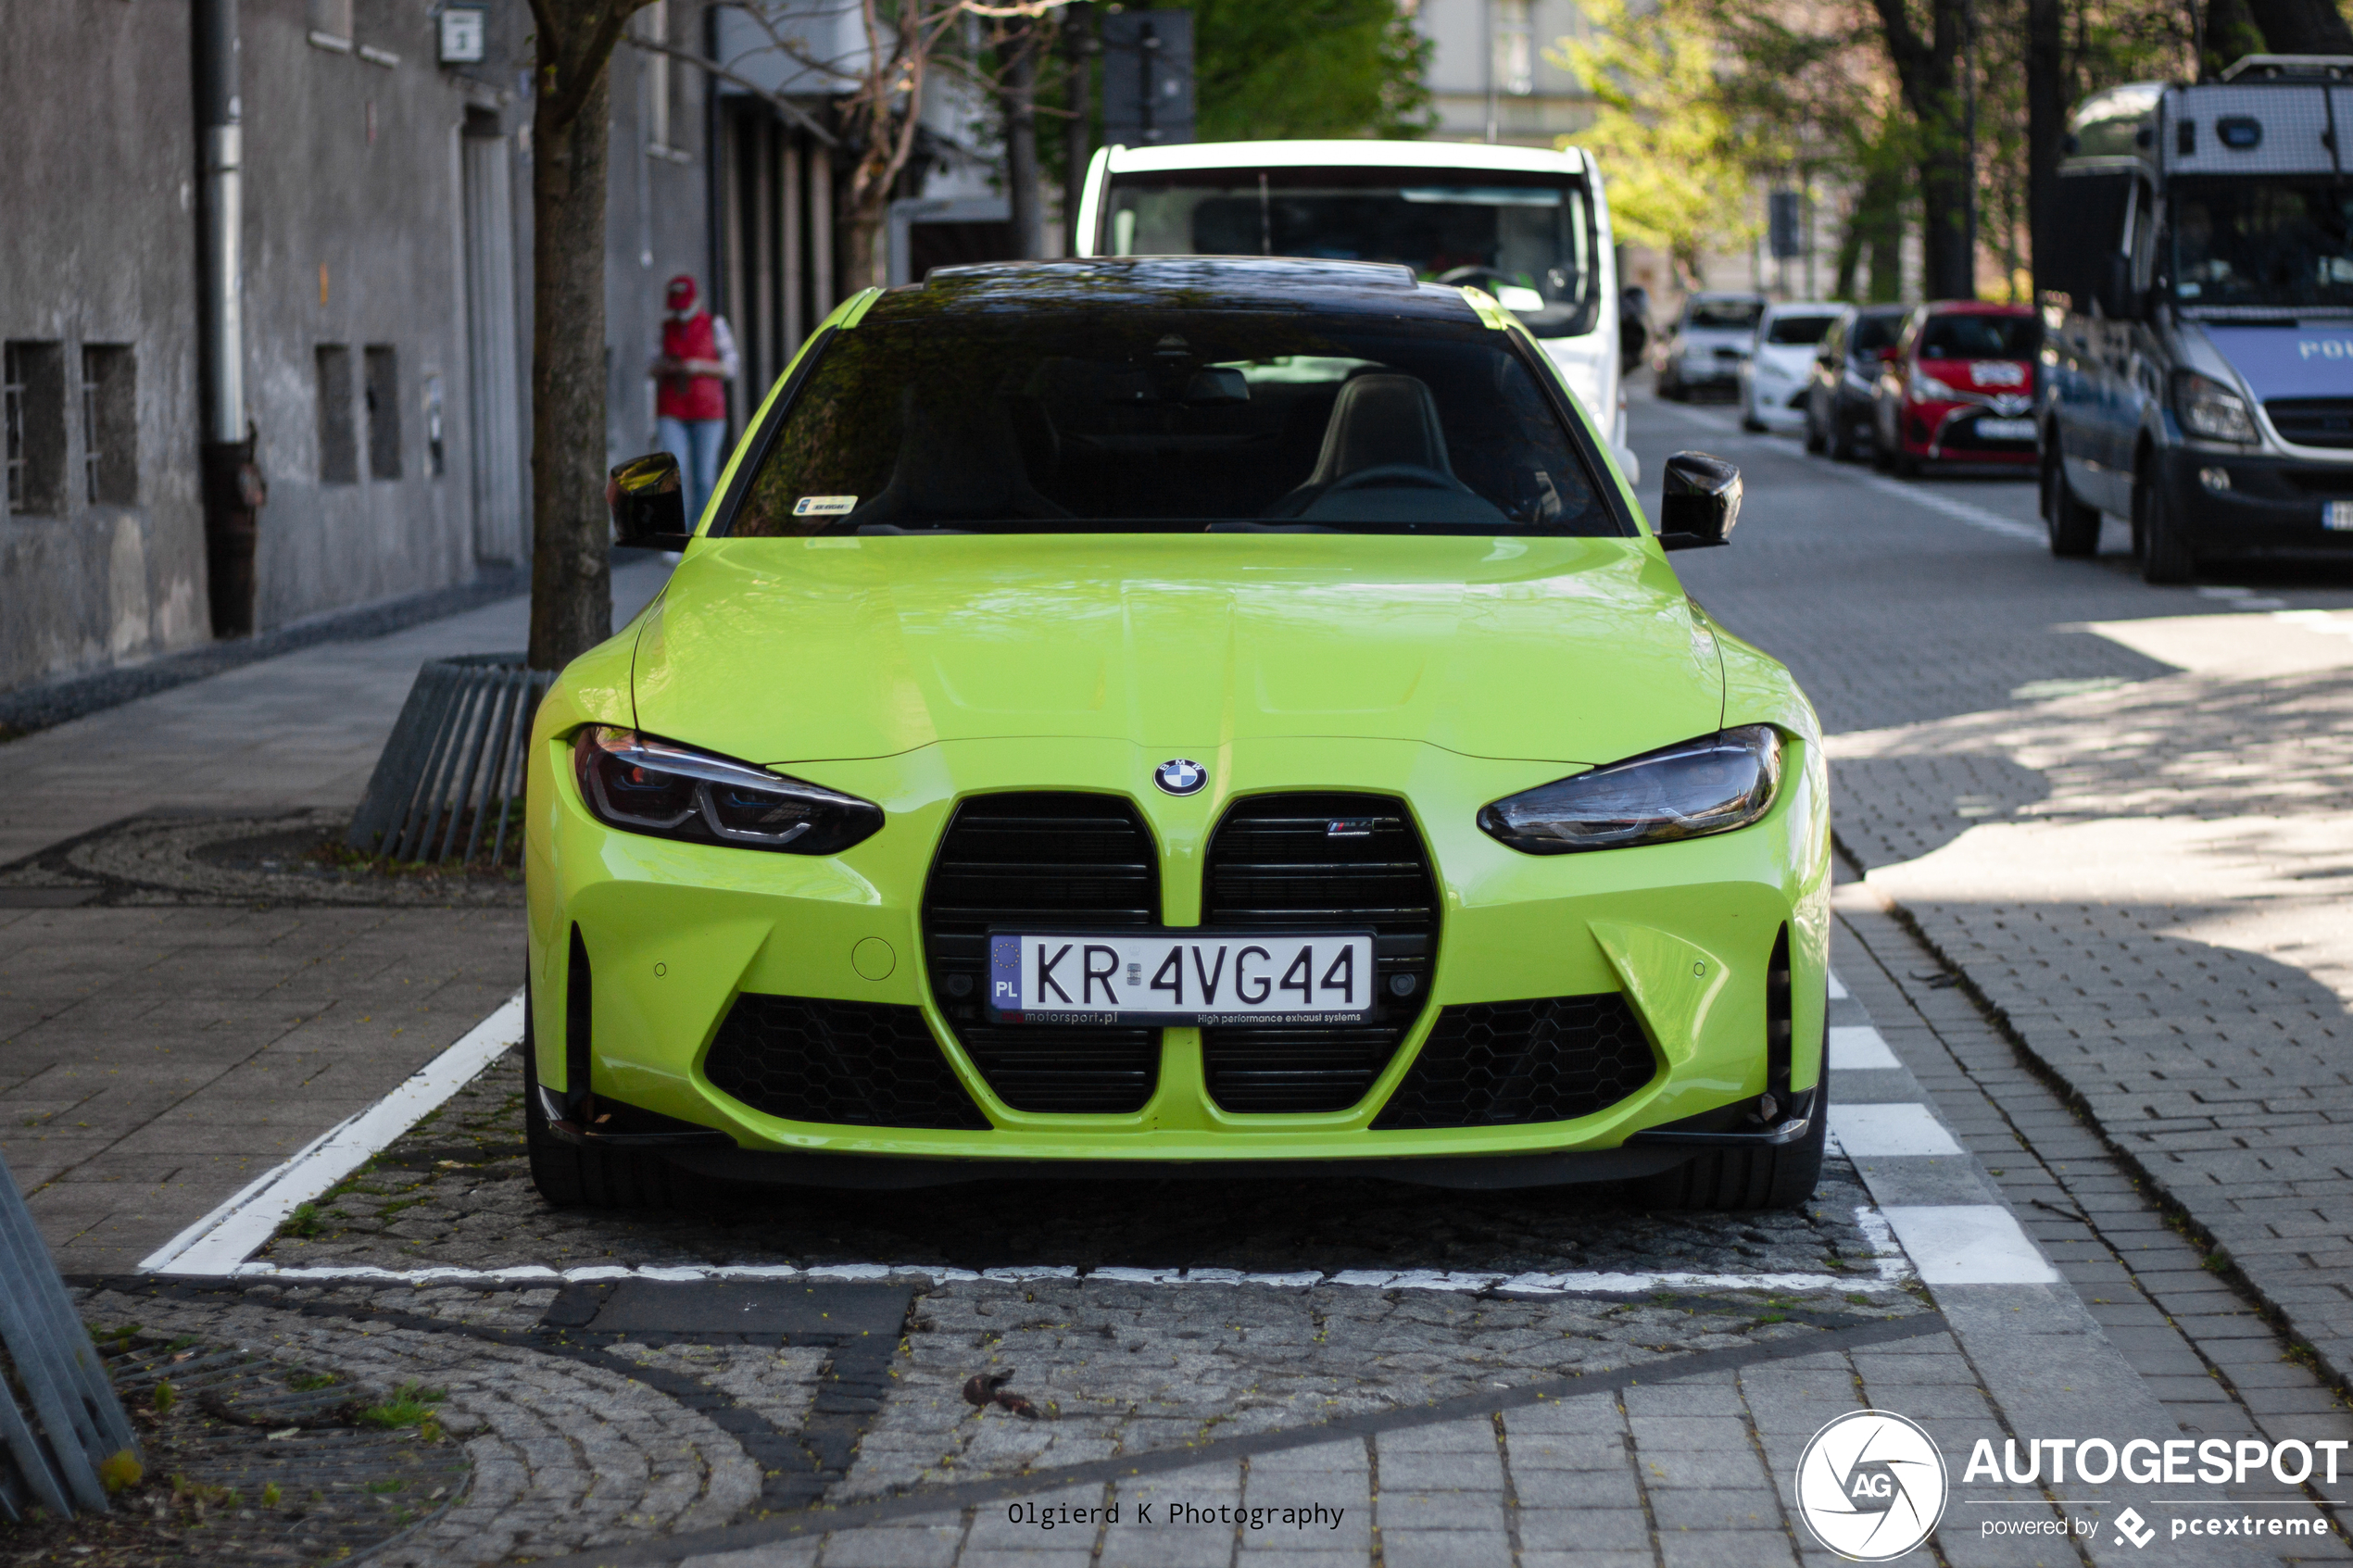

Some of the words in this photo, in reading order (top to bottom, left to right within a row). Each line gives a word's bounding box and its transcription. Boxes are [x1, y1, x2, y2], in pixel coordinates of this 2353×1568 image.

[1159, 759, 1202, 771] BMW
[1038, 943, 1120, 1004] KR
[1150, 944, 1353, 1005] 4VG44
[996, 981, 1018, 997] PL
[1197, 1013, 1219, 1025] High
[1221, 1013, 1283, 1024] performance
[1285, 1012, 1322, 1022] exhaust
[1324, 1012, 1361, 1022] systems
